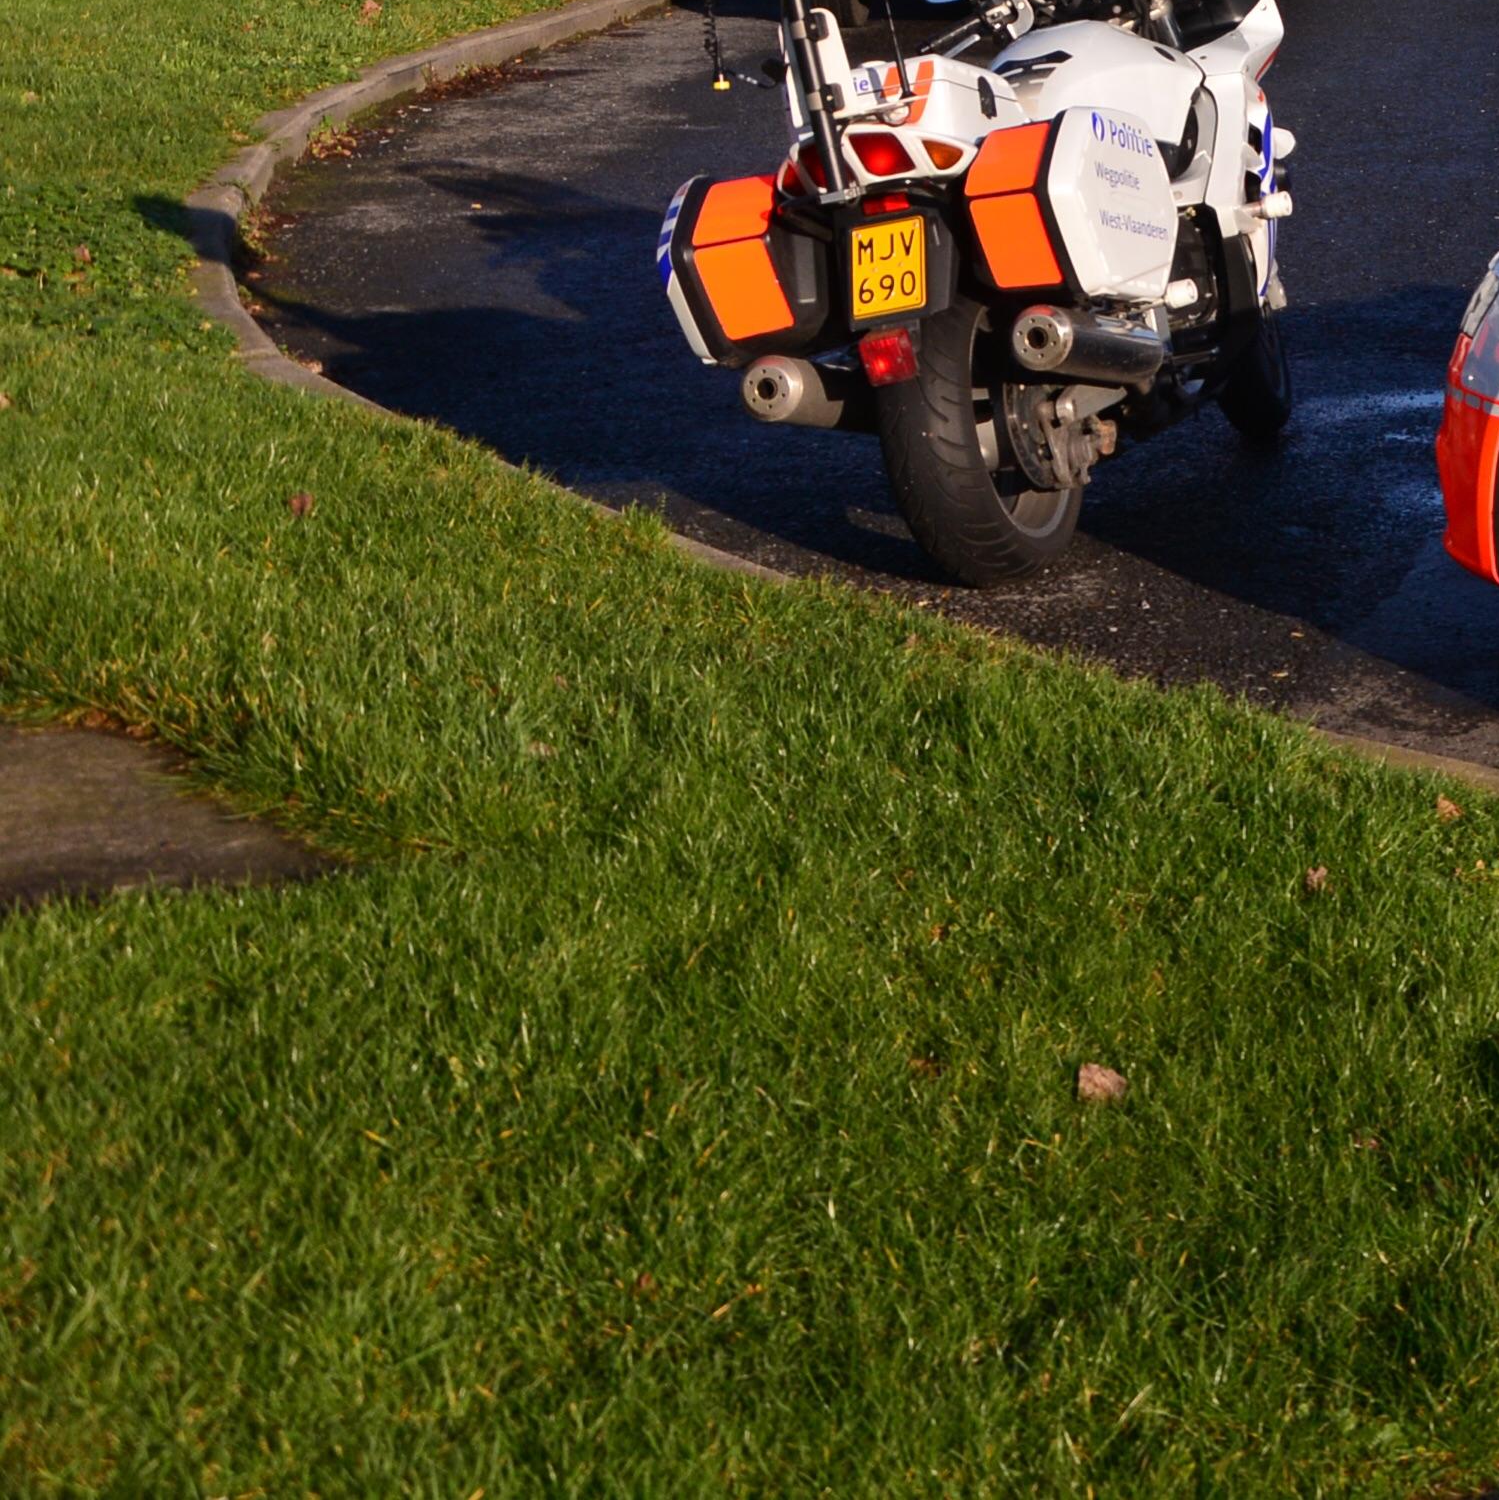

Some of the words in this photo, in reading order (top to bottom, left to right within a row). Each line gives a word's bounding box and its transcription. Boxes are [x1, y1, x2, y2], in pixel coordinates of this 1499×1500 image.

[1107, 119, 1154, 158] Politie
[1094, 160, 1141, 190] Wegpolitie
[1099, 209, 1169, 241] West-Vlaanderen
[857, 228, 916, 266] MJV
[858, 270, 916, 305] 690
